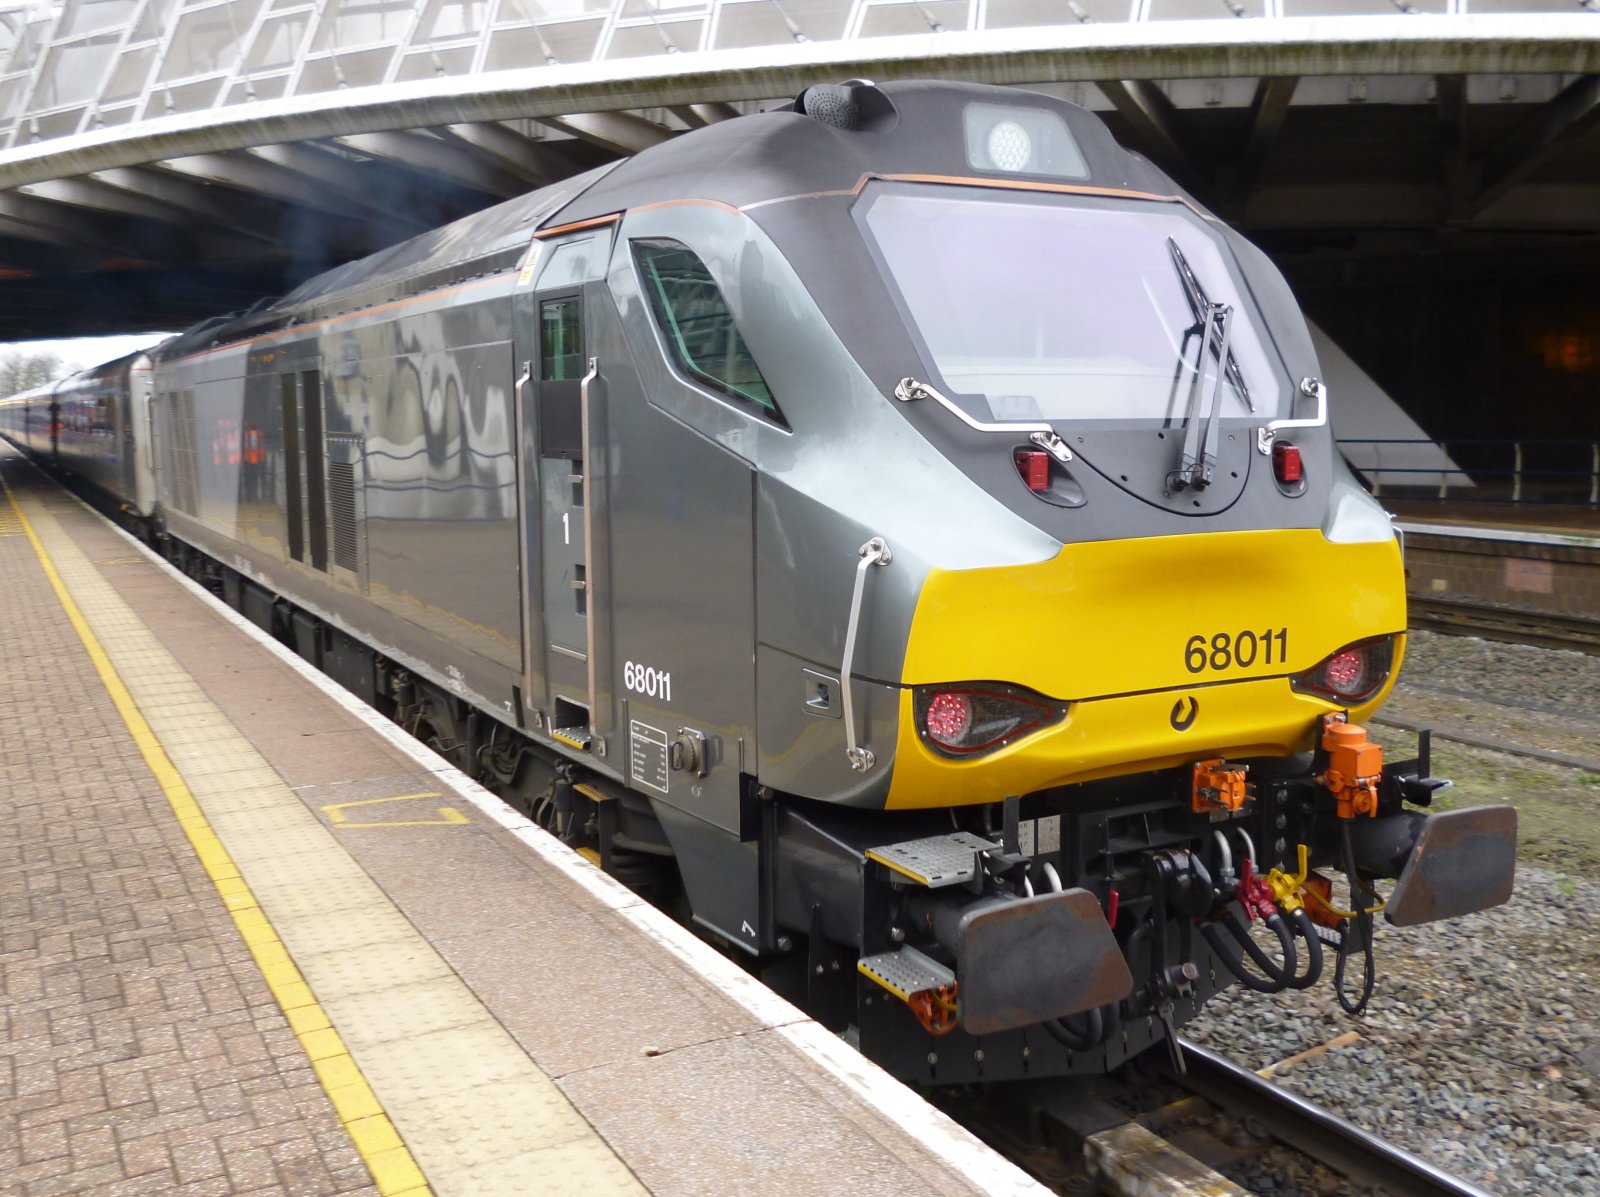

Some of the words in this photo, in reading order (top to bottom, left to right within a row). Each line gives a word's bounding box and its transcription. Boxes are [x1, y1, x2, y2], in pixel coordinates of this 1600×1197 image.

[562, 512, 570, 545] 1
[1185, 627, 1288, 674] 68011
[624, 660, 671, 702] 68011
